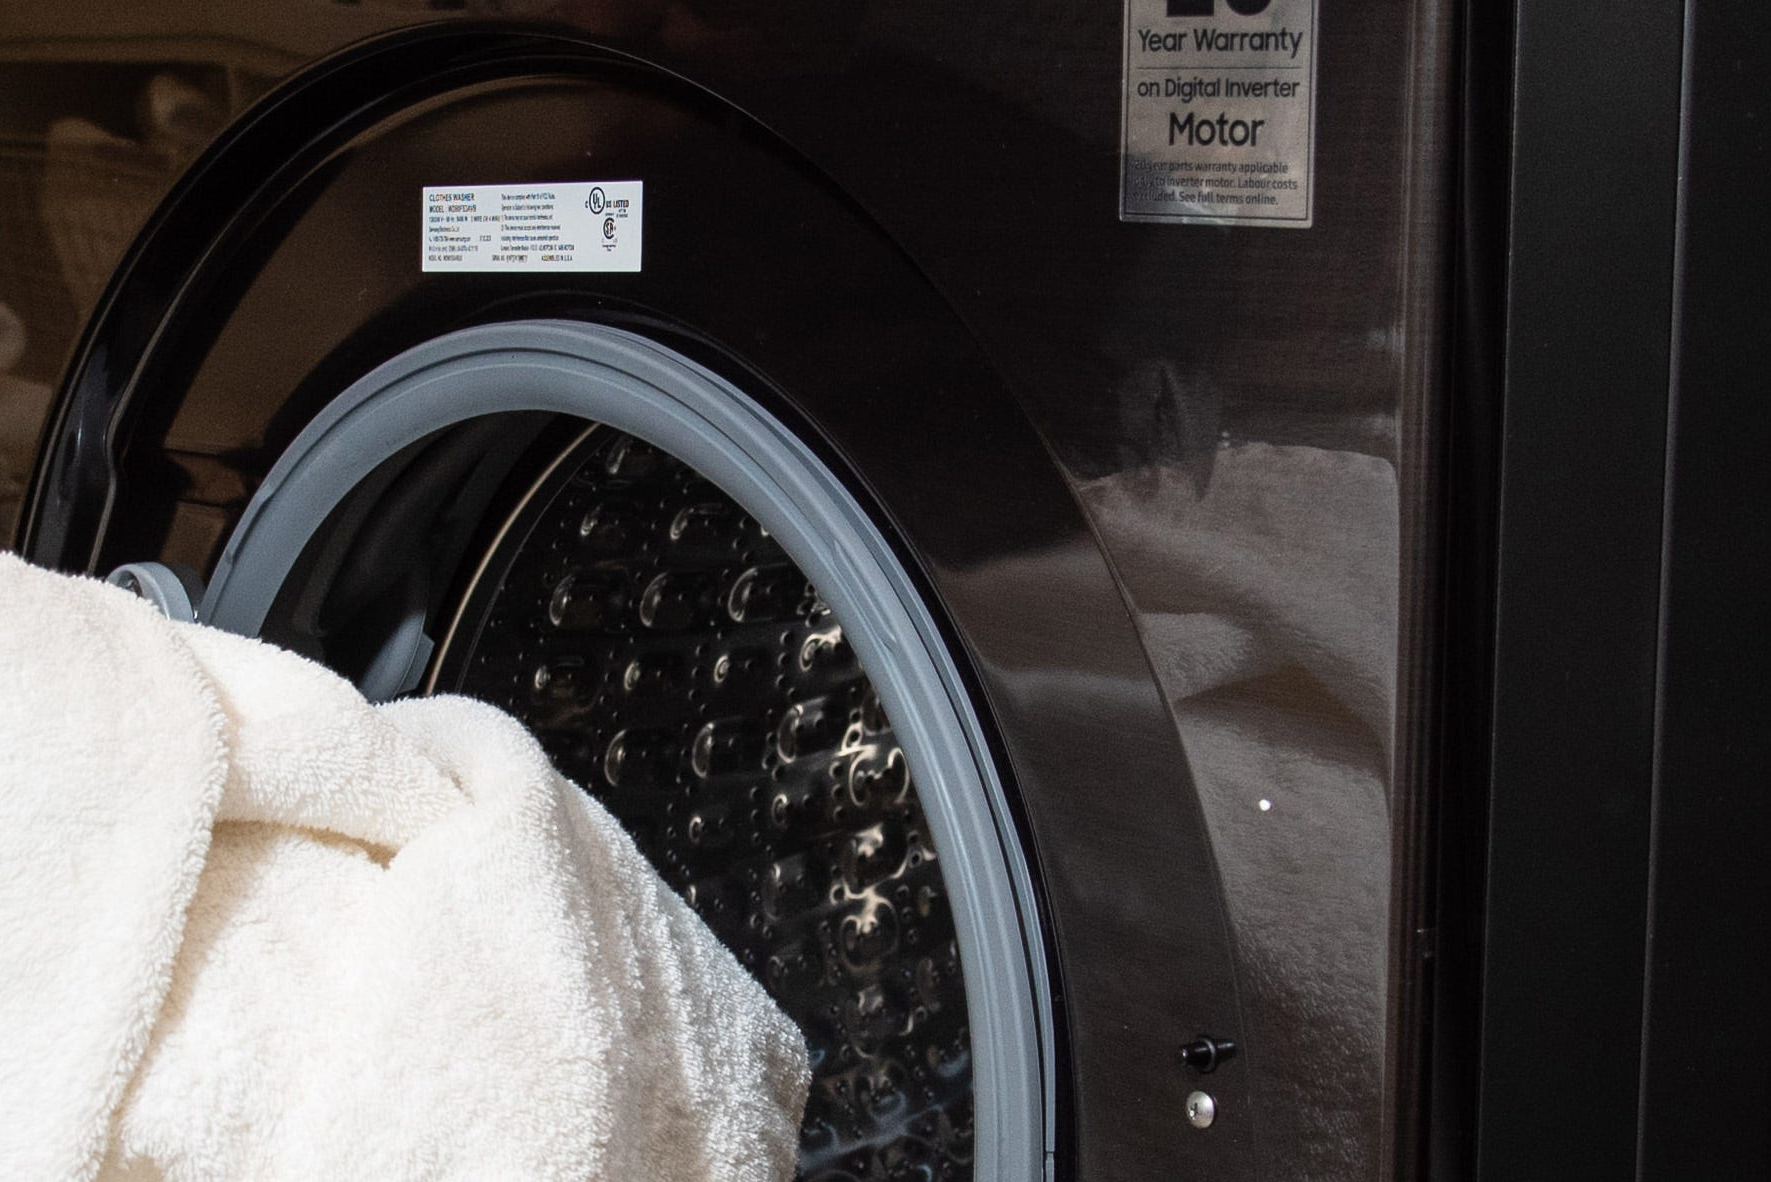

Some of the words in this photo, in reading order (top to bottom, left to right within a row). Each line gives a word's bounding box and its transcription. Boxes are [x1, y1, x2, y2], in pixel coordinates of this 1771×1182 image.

[1137, 29, 1187, 51] Year
[1193, 27, 1303, 59] Warranty
[1137, 80, 1160, 97] on
[1165, 77, 1220, 102] Digital
[1225, 78, 1300, 98] Inverter
[1168, 112, 1265, 147] Motor
[1195, 162, 1237, 174] warranty
[1239, 160, 1289, 174] applicable
[1272, 178, 1298, 190] costs
[453, 192, 475, 201] WASHER
[1215, 193, 1244, 204] terms
[613, 199, 630, 208] LISTED
